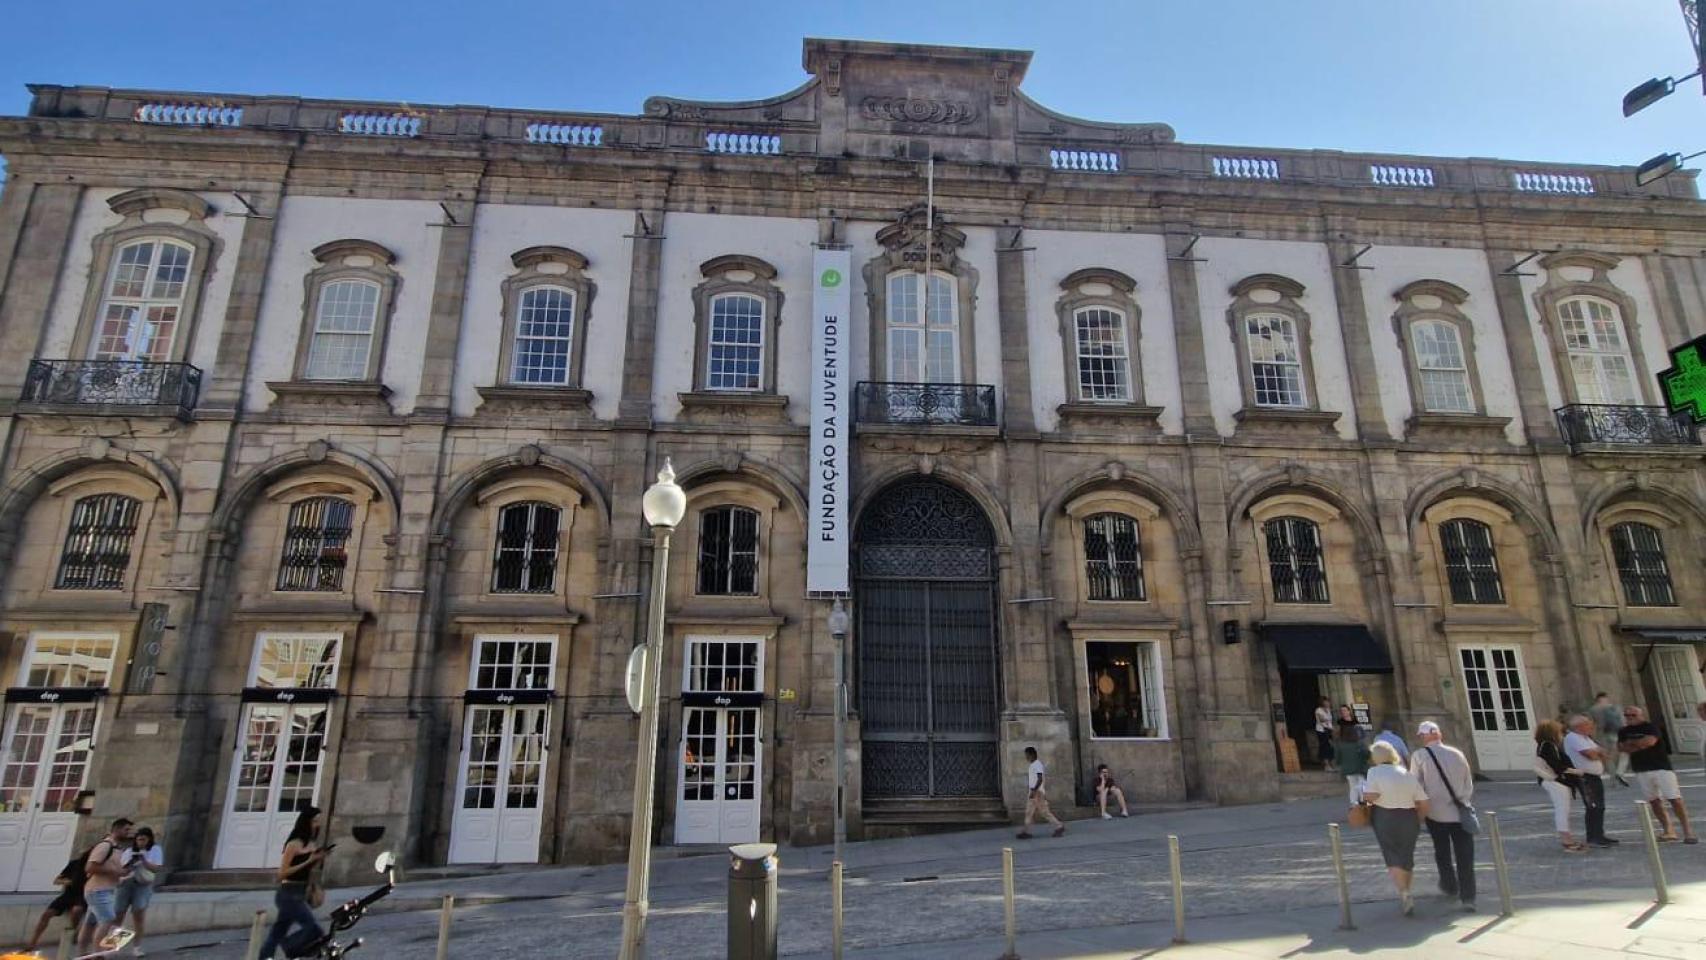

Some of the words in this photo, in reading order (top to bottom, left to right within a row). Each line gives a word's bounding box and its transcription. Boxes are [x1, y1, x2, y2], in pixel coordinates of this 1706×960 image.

[824, 315, 838, 411] JUVENTUDE
[823, 416, 836, 438] DA
[820, 445, 839, 541] FUNDAÇÃO
